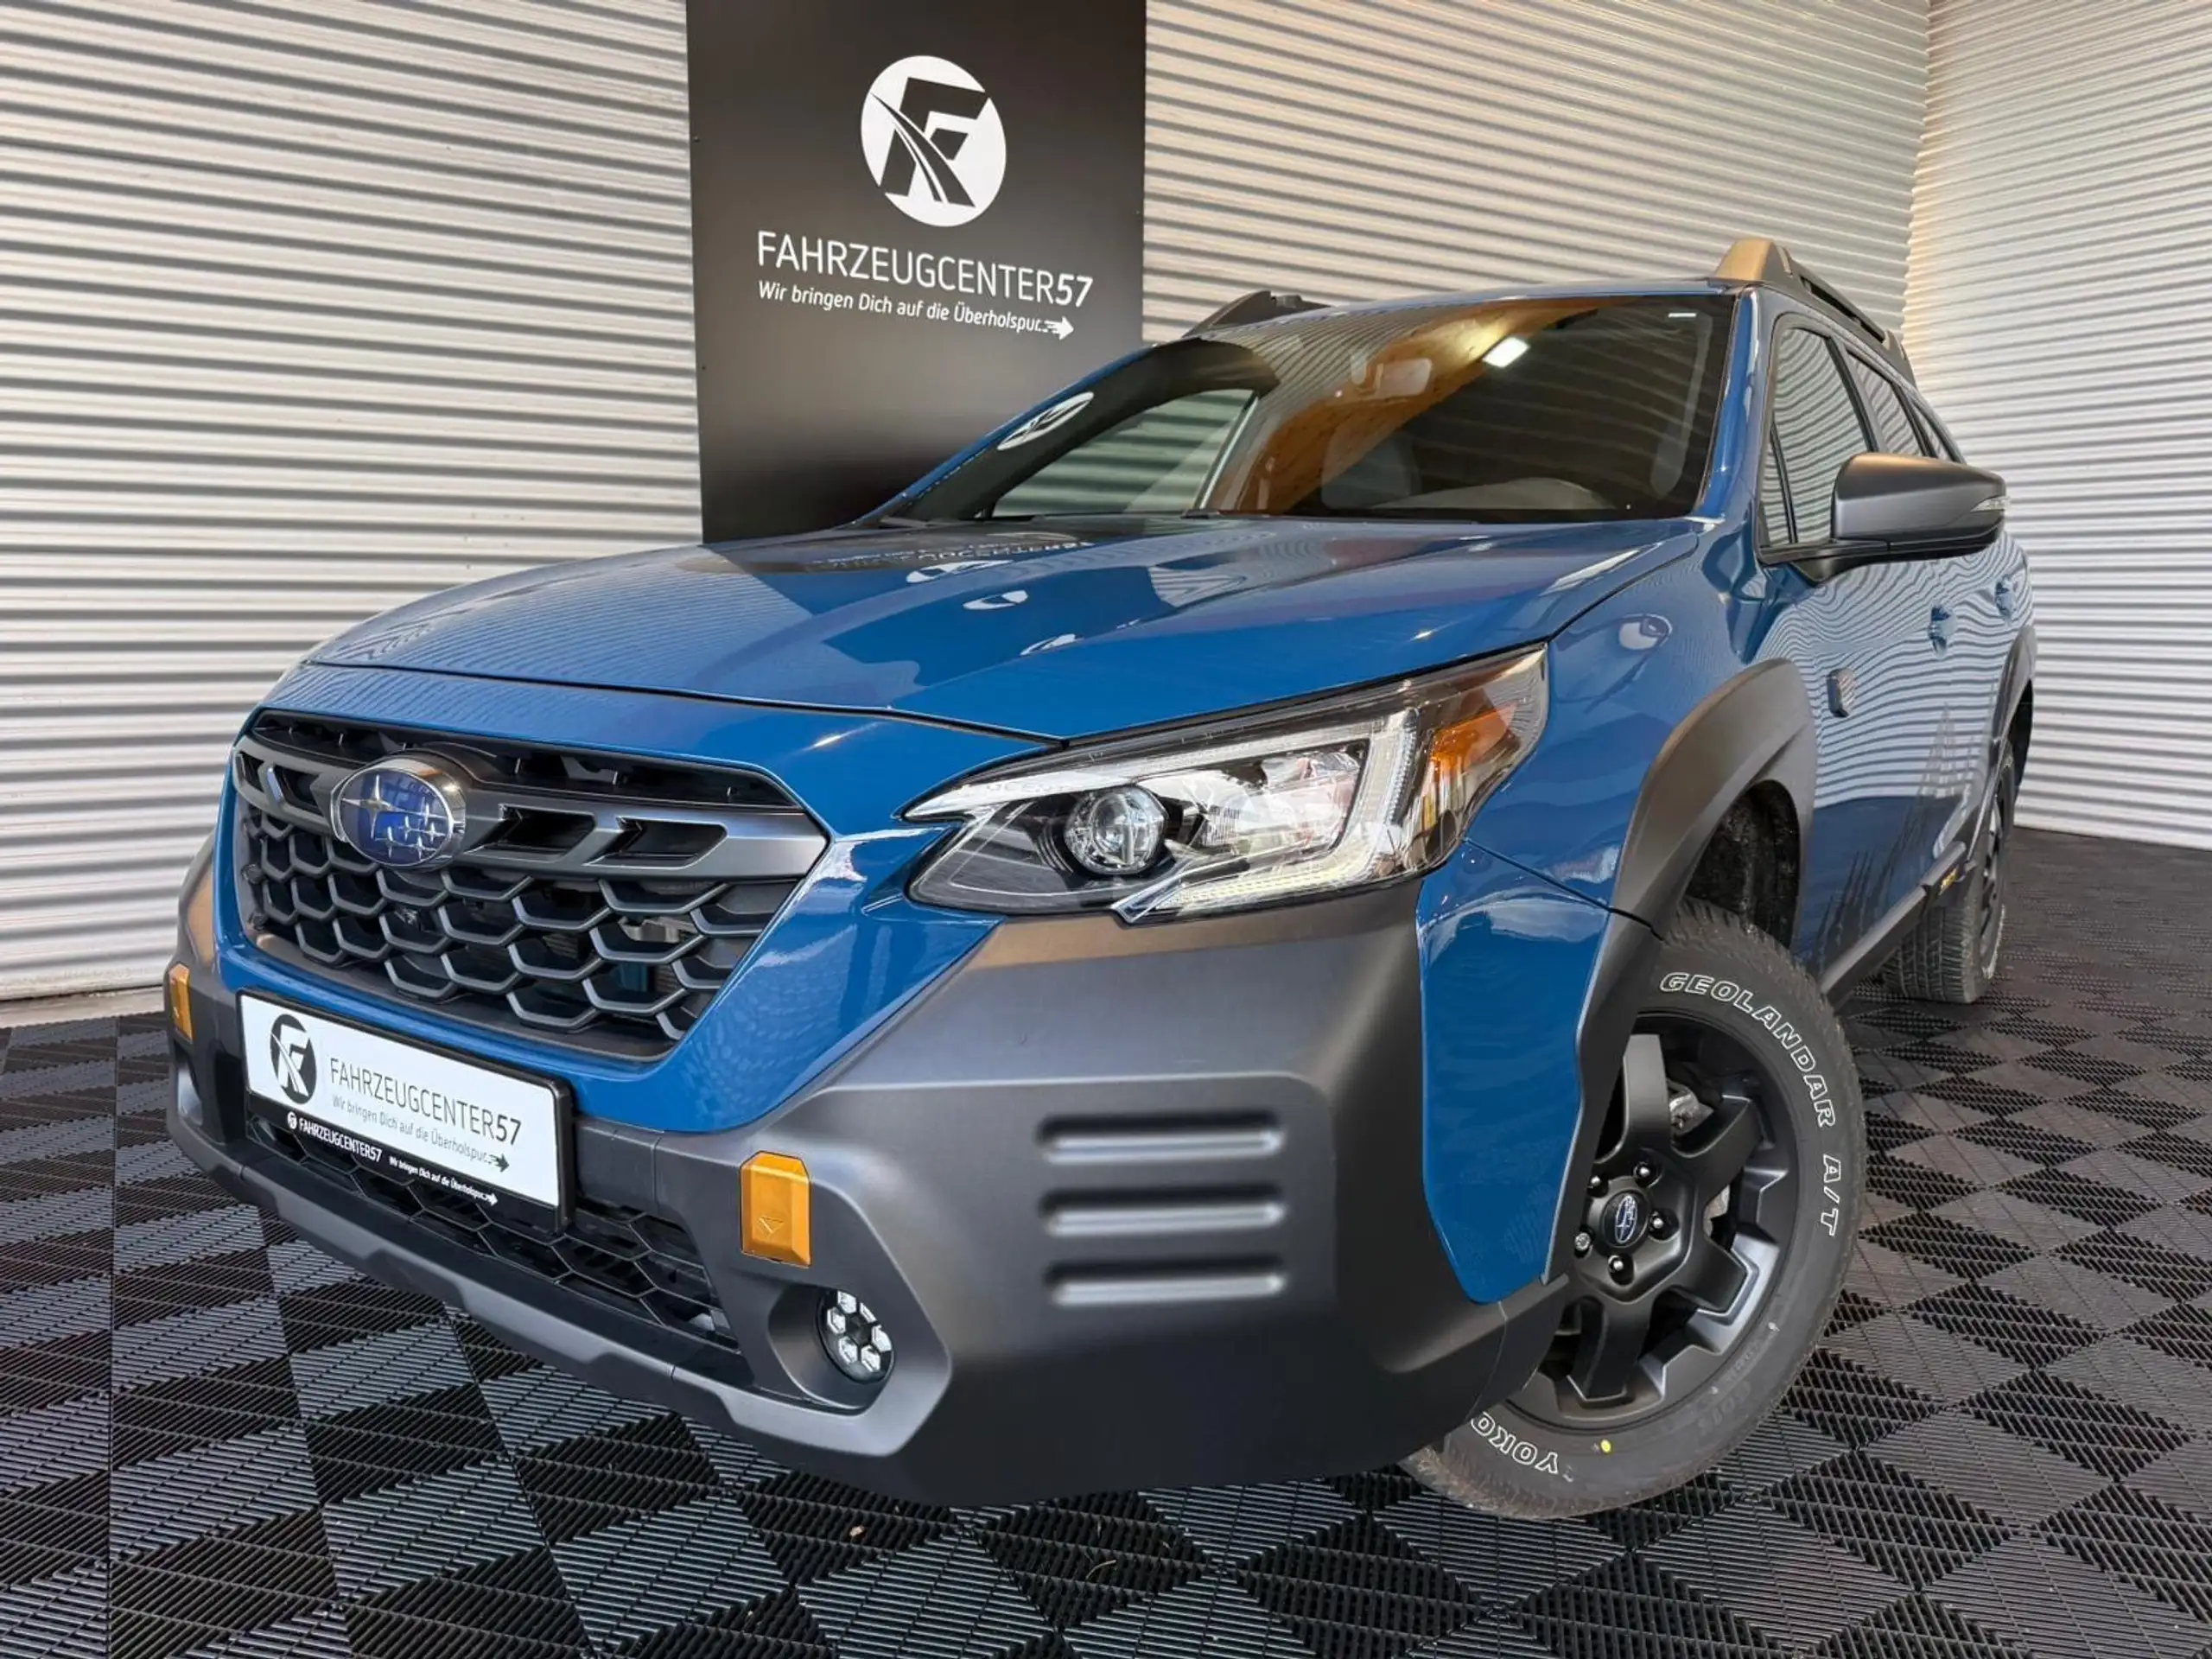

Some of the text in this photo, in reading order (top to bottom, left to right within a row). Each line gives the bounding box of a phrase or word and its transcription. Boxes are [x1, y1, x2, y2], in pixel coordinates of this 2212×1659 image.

[757, 230, 1094, 308] FAHRZEUGCENTER57
[758, 279, 787, 300] Wir
[791, 284, 854, 311] bringen
[858, 293, 892, 314] Dich
[896, 300, 924, 317] auf
[926, 302, 950, 321] die
[330, 1057, 522, 1145] FAHRZEUGCENTER57
[333, 1095, 346, 1110] Wir
[346, 1098, 378, 1123] bringen
[379, 1111, 397, 1130] Dich
[399, 1122, 414, 1135] auf
[416, 1126, 429, 1141] die
[1660, 971, 1841, 1236] GEOLANDAR A/T
[299, 1117, 383, 1162] FAHRZEUGCENTER57
